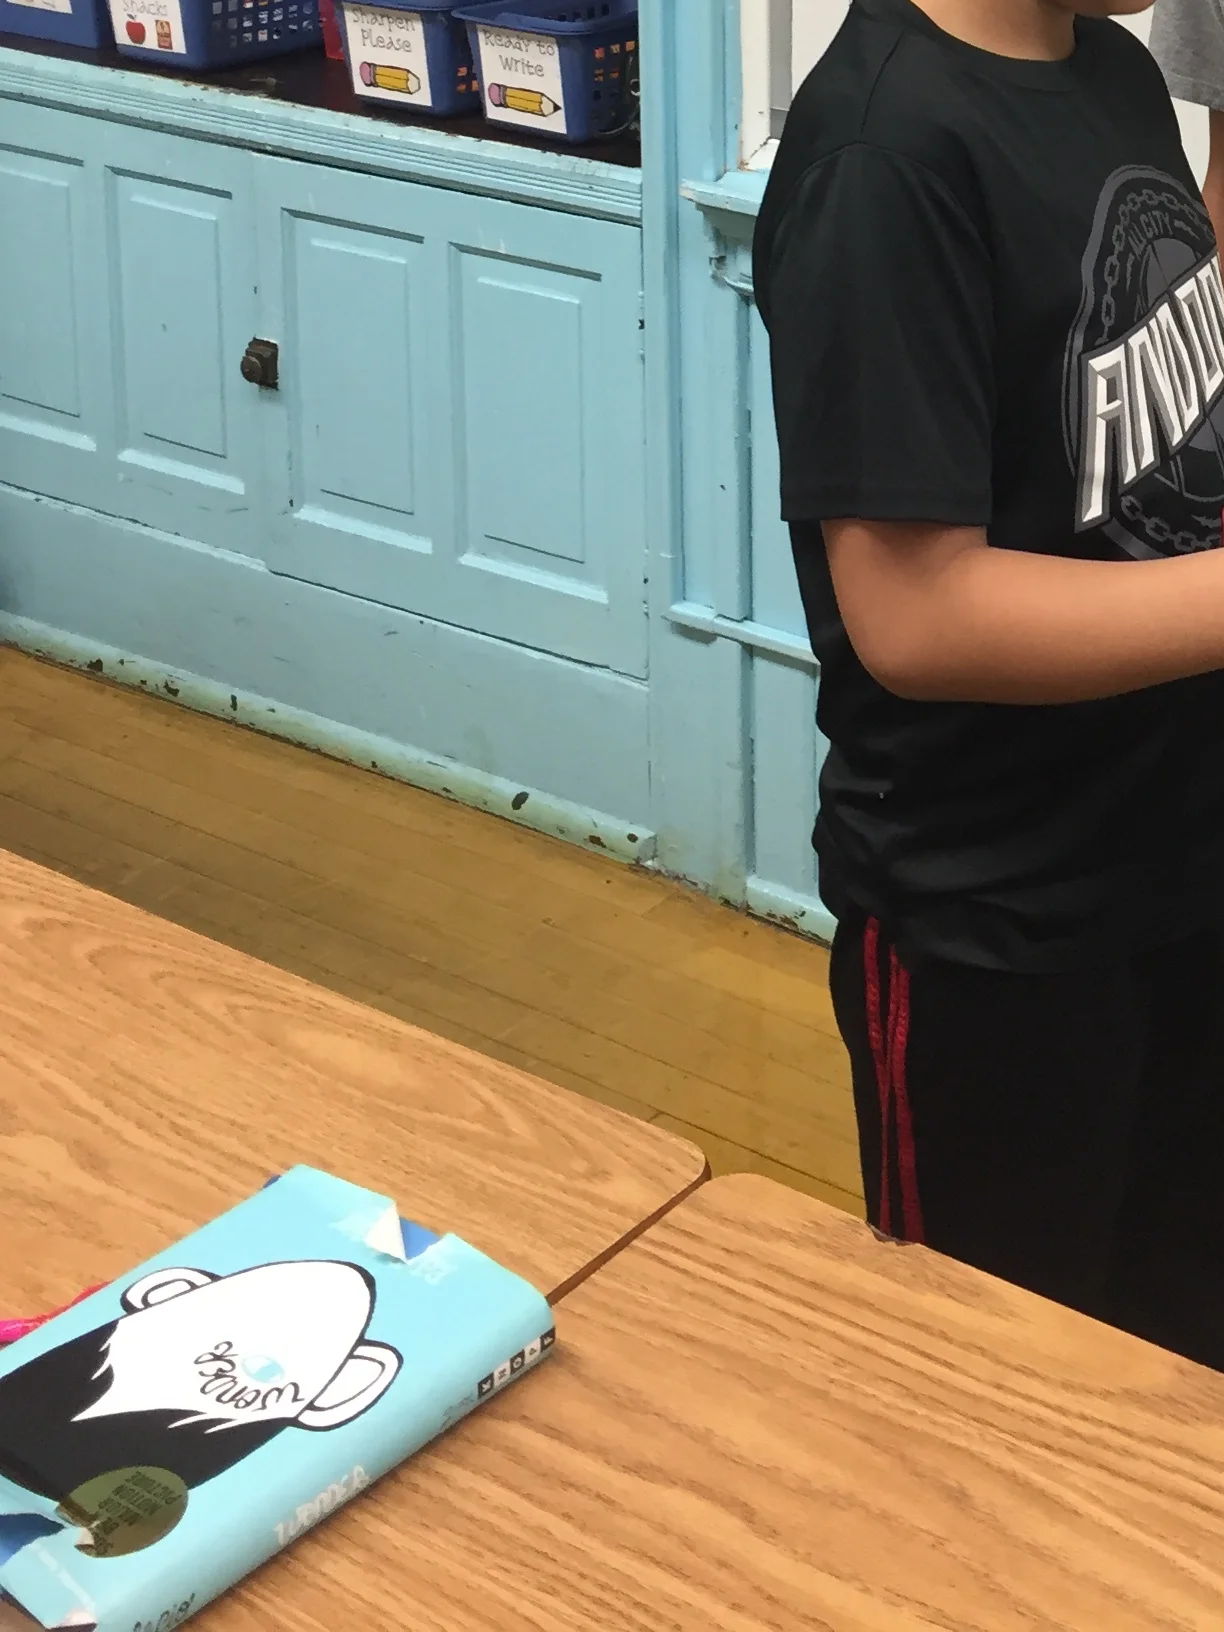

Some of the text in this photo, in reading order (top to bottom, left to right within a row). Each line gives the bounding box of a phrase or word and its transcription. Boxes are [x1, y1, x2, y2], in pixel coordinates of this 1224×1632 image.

[123, 1, 168, 17] Snacks
[353, 8, 416, 32] Sharpen
[361, 28, 412, 53] Please
[484, 29, 555, 56] Ready to
[1140, 210, 1173, 238] CITY
